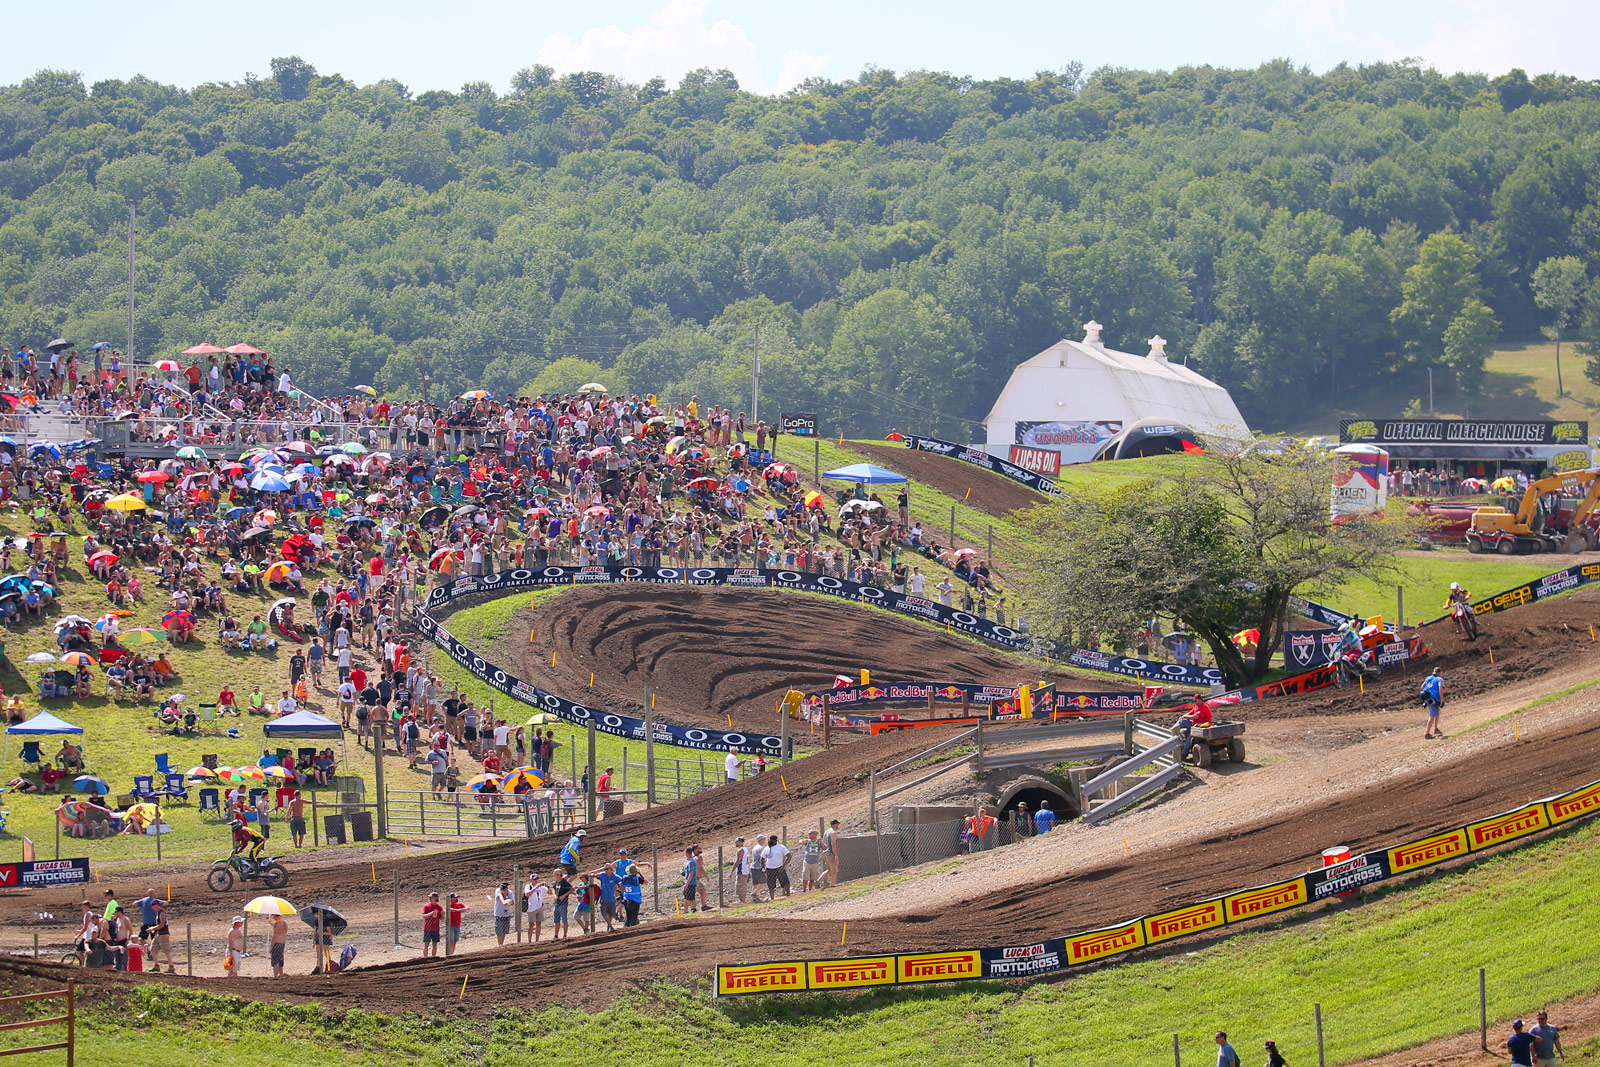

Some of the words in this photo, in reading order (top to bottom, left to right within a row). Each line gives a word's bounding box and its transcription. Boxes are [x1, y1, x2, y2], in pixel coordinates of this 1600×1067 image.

[784, 418, 814, 428] GoPro
[1143, 425, 1175, 434] WPS
[1347, 421, 1375, 433] MOTO
[1552, 423, 1579, 436] MOTO
[1034, 433, 1097, 443] UNADILLA
[1351, 428, 1378, 440] TEES
[1383, 422, 1443, 440] OFFICIAL
[1447, 423, 1545, 441] MERCHANDISE
[1556, 430, 1582, 442] TEES
[1014, 448, 1042, 471] LUCAS
[1043, 451, 1056, 473] OIL
[1553, 451, 1587, 466] MOTO
[1558, 460, 1590, 473] TEES
[1543, 574, 1558, 584] LUCAS
[481, 582, 504, 591] OAKLEY
[810, 584, 847, 597] OAKLEY
[1536, 577, 1577, 597] MOTOCROSS
[850, 593, 889, 606] OAKLEY
[1494, 586, 1531, 607] GEICO
[896, 601, 939, 617] MOTOCROSS
[943, 617, 981, 634] OAKLEY
[984, 631, 1021, 647] OAKLEY
[452, 651, 469, 666] OAKLEY
[1298, 645, 1309, 659] X
[1114, 667, 1152, 677] OAKLEY
[1154, 673, 1192, 682] OAKLEY
[489, 677, 508, 692] OAKLEY
[891, 685, 911, 697] Red
[841, 690, 857, 702] Bull
[1100, 695, 1120, 708] Red
[1121, 695, 1140, 708] Bull
[540, 703, 565, 716] OAKLEY
[567, 713, 589, 726] OAKLE
[596, 723, 627, 736] OAKLEY
[633, 729, 673, 741] MOTCROSS
[677, 739, 713, 749] OAKLEY
[1474, 809, 1540, 844] PIRELLI
[1394, 835, 1460, 868] PIRELLI
[36, 862, 58, 870] LUCAS
[1329, 864, 1351, 878] LUCAS
[1353, 857, 1365, 869] OIL
[23, 870, 84, 882] MOTOCROSS
[1315, 866, 1382, 895] MOTOCROSS
[1231, 884, 1298, 916] PIRELLI
[1151, 905, 1216, 938] PIRELLI
[1073, 927, 1136, 958] PIRELLI
[1005, 947, 1030, 958] LUCAS
[1031, 945, 1043, 955] OIL
[905, 955, 973, 977] PIRELLI
[990, 955, 1060, 973] MOTOCROSS
[815, 962, 887, 983] PIRELLI
[990, 965, 1061, 977] CHAMPIONSHIP
[726, 967, 798, 989] PIRELLI
